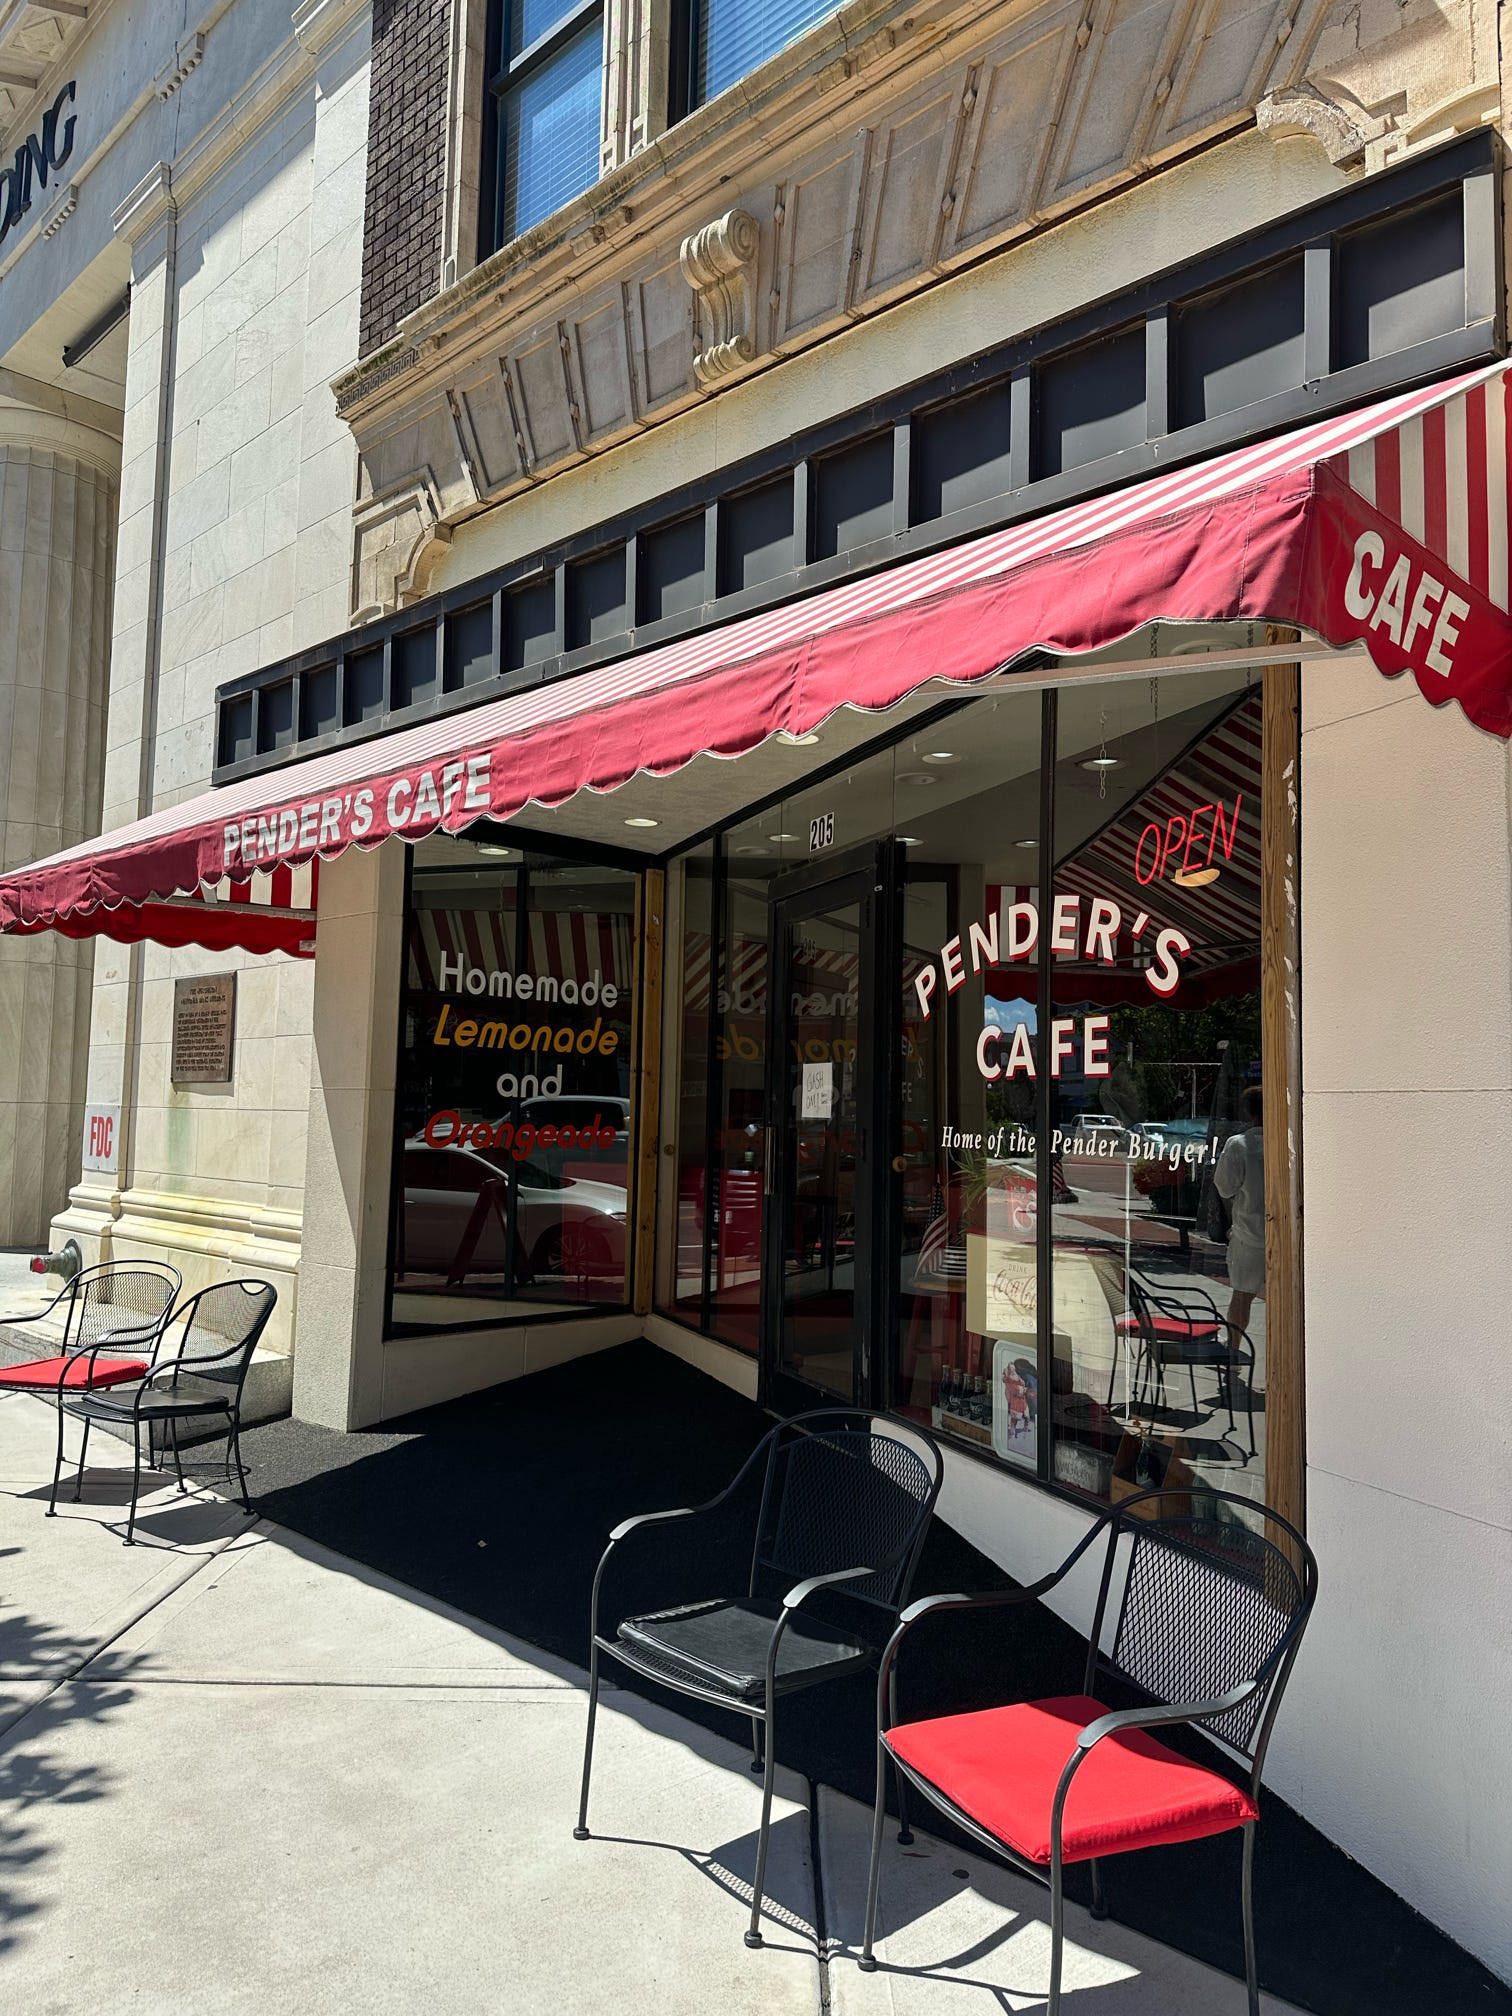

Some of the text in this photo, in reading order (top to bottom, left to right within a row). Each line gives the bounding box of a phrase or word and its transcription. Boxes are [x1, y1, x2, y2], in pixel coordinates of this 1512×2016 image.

[1344, 530, 1470, 678] CAFE
[223, 754, 491, 867] PENDER'S CAFE
[811, 814, 833, 851] 205
[1135, 793, 1242, 885] OPEN
[439, 950, 618, 1009] Homemade
[914, 894, 1192, 1022] PENDER'S
[433, 1004, 619, 1055] Lemonade
[976, 1016, 1112, 1081] CAFE
[496, 1064, 563, 1098] and
[90, 1116, 113, 1159] FDC
[424, 1109, 617, 1162] Orangeade
[941, 1126, 983, 1150] Home
[987, 1127, 1005, 1160] of
[1009, 1127, 1036, 1153] the
[1051, 1129, 1119, 1159] Pender
[1127, 1136, 1219, 1172] Burger!
